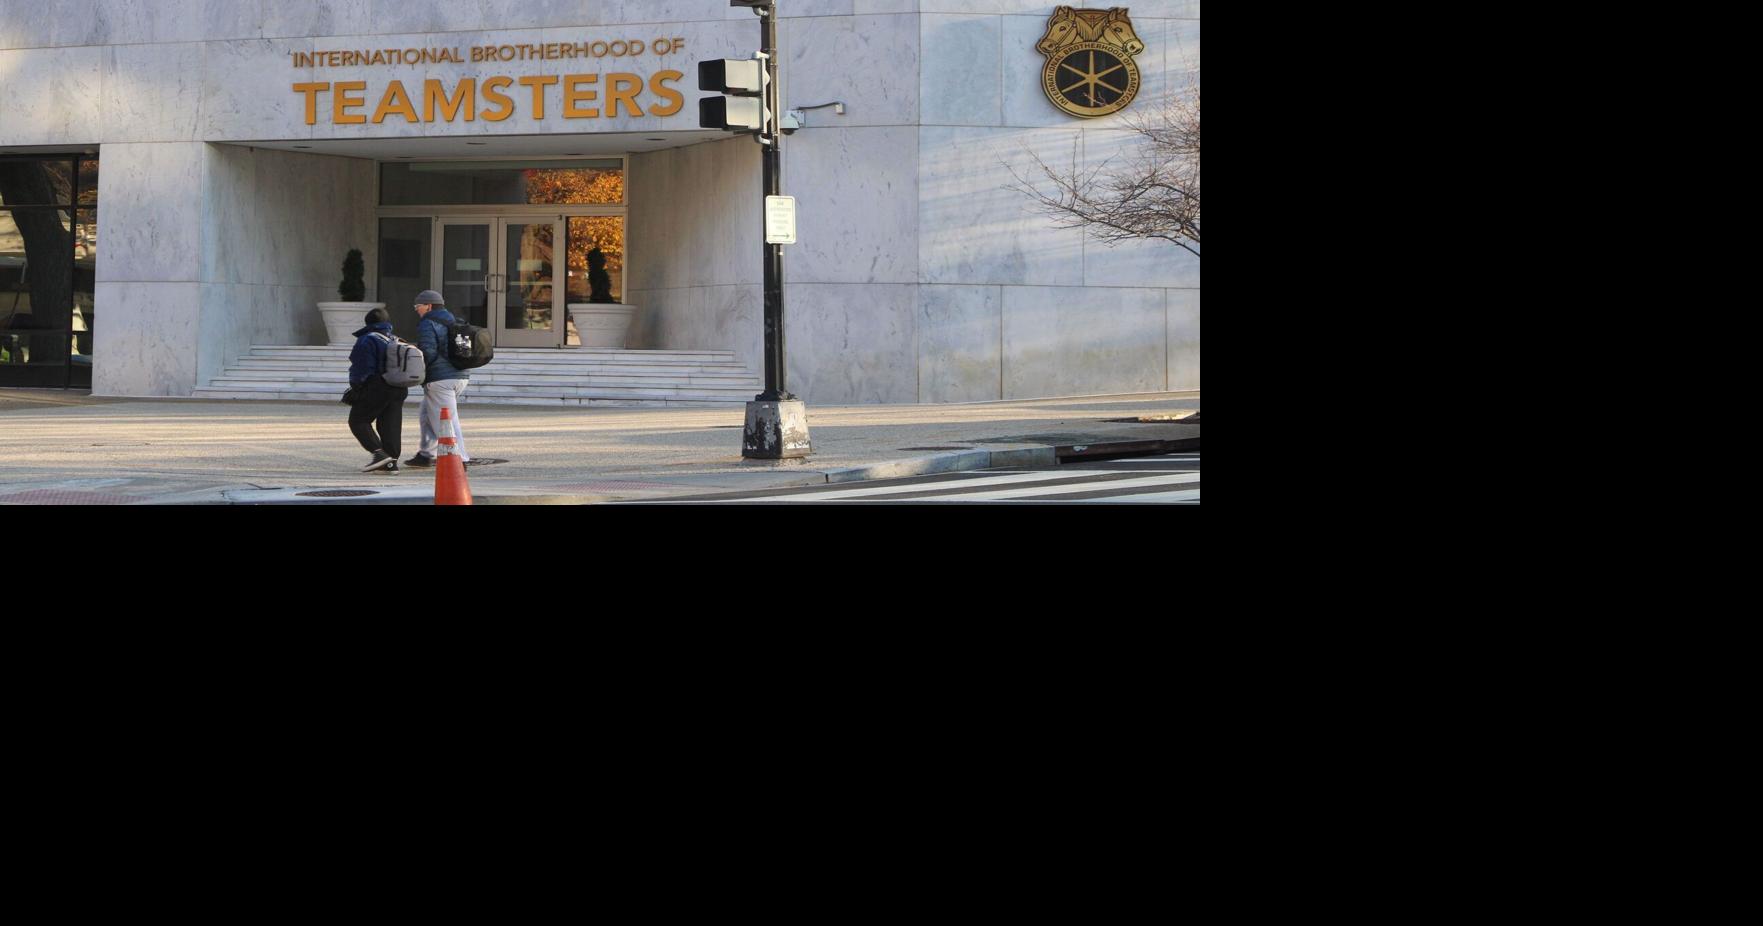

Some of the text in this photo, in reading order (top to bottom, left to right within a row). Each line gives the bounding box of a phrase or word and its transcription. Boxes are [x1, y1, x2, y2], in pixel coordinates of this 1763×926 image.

[293, 37, 685, 68] INTERNATIONAL BROTHERHOOD OF
[1047, 42, 1136, 106] INTERNATIONAL BROTHERHOOD OF TEAMSTERS
[292, 70, 684, 125] TEAMSTERS
